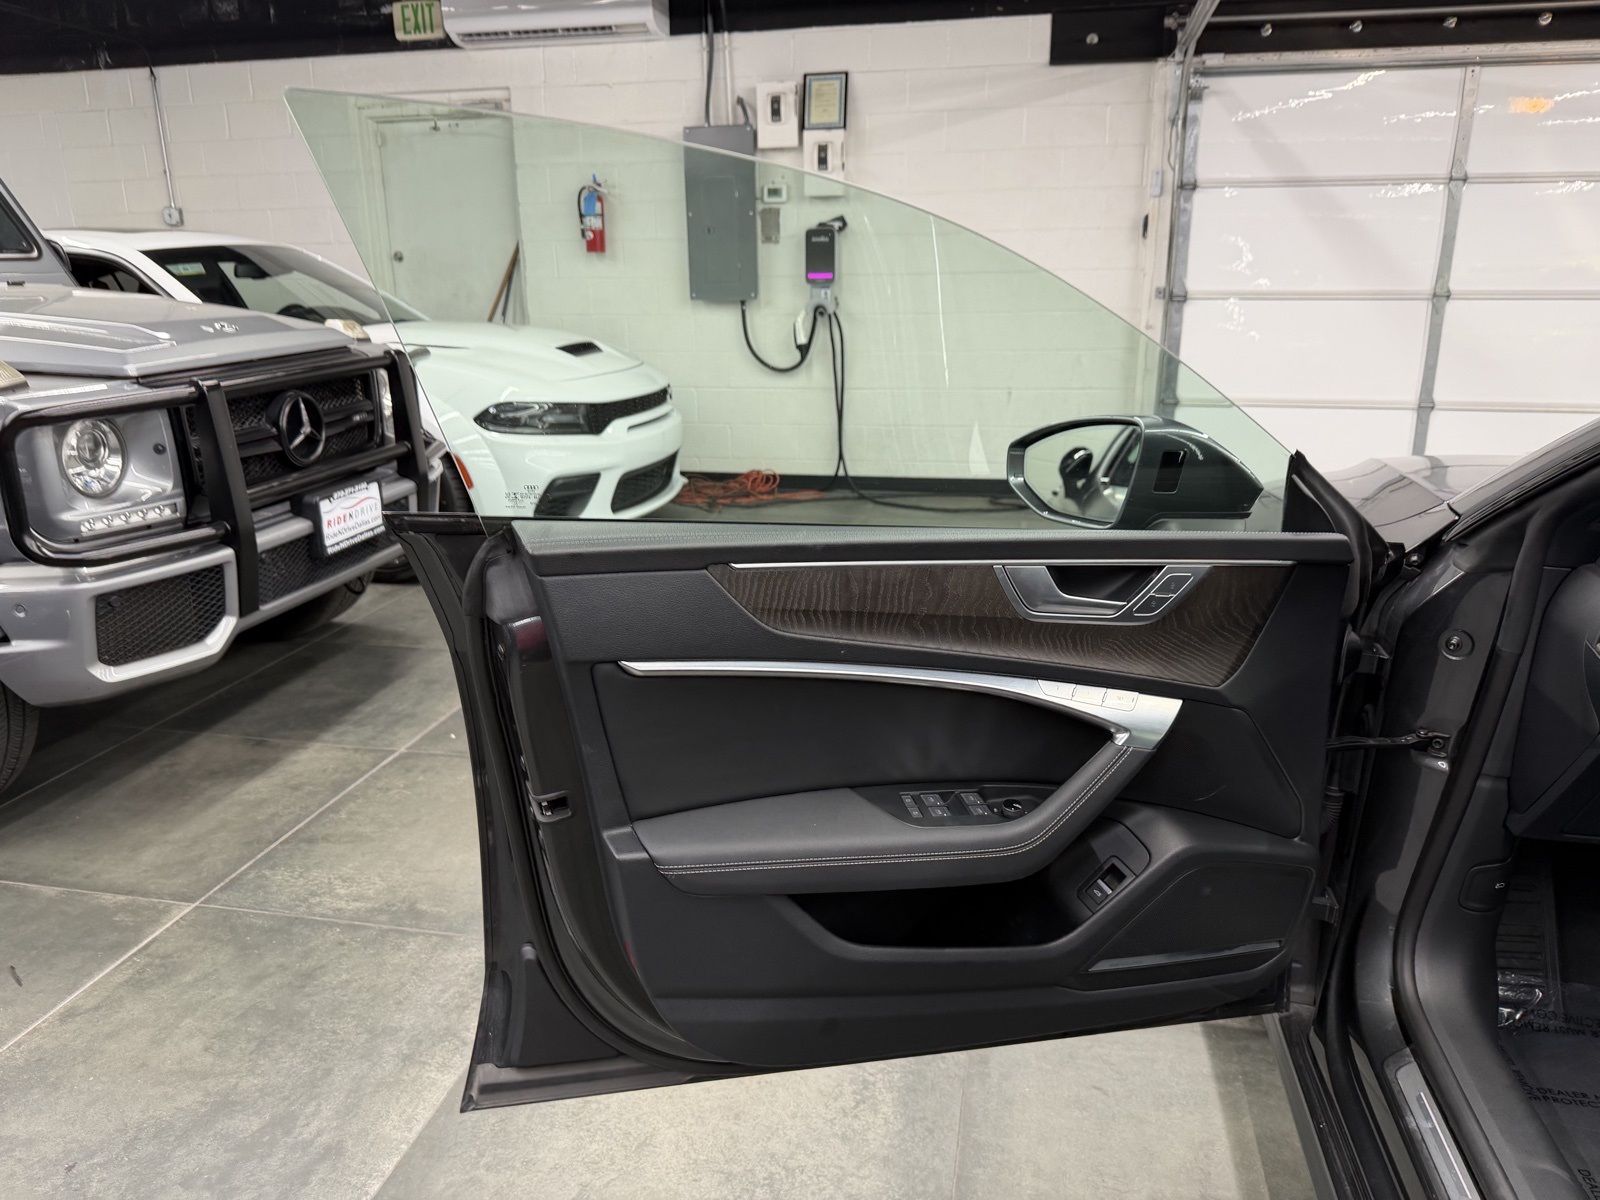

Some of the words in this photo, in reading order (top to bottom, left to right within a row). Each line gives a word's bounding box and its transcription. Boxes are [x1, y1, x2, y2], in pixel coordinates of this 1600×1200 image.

[400, 2, 435, 36] EXIT
[326, 502, 379, 529] RIDENDRIVE
[1536, 1087, 1590, 1100] DEALER
